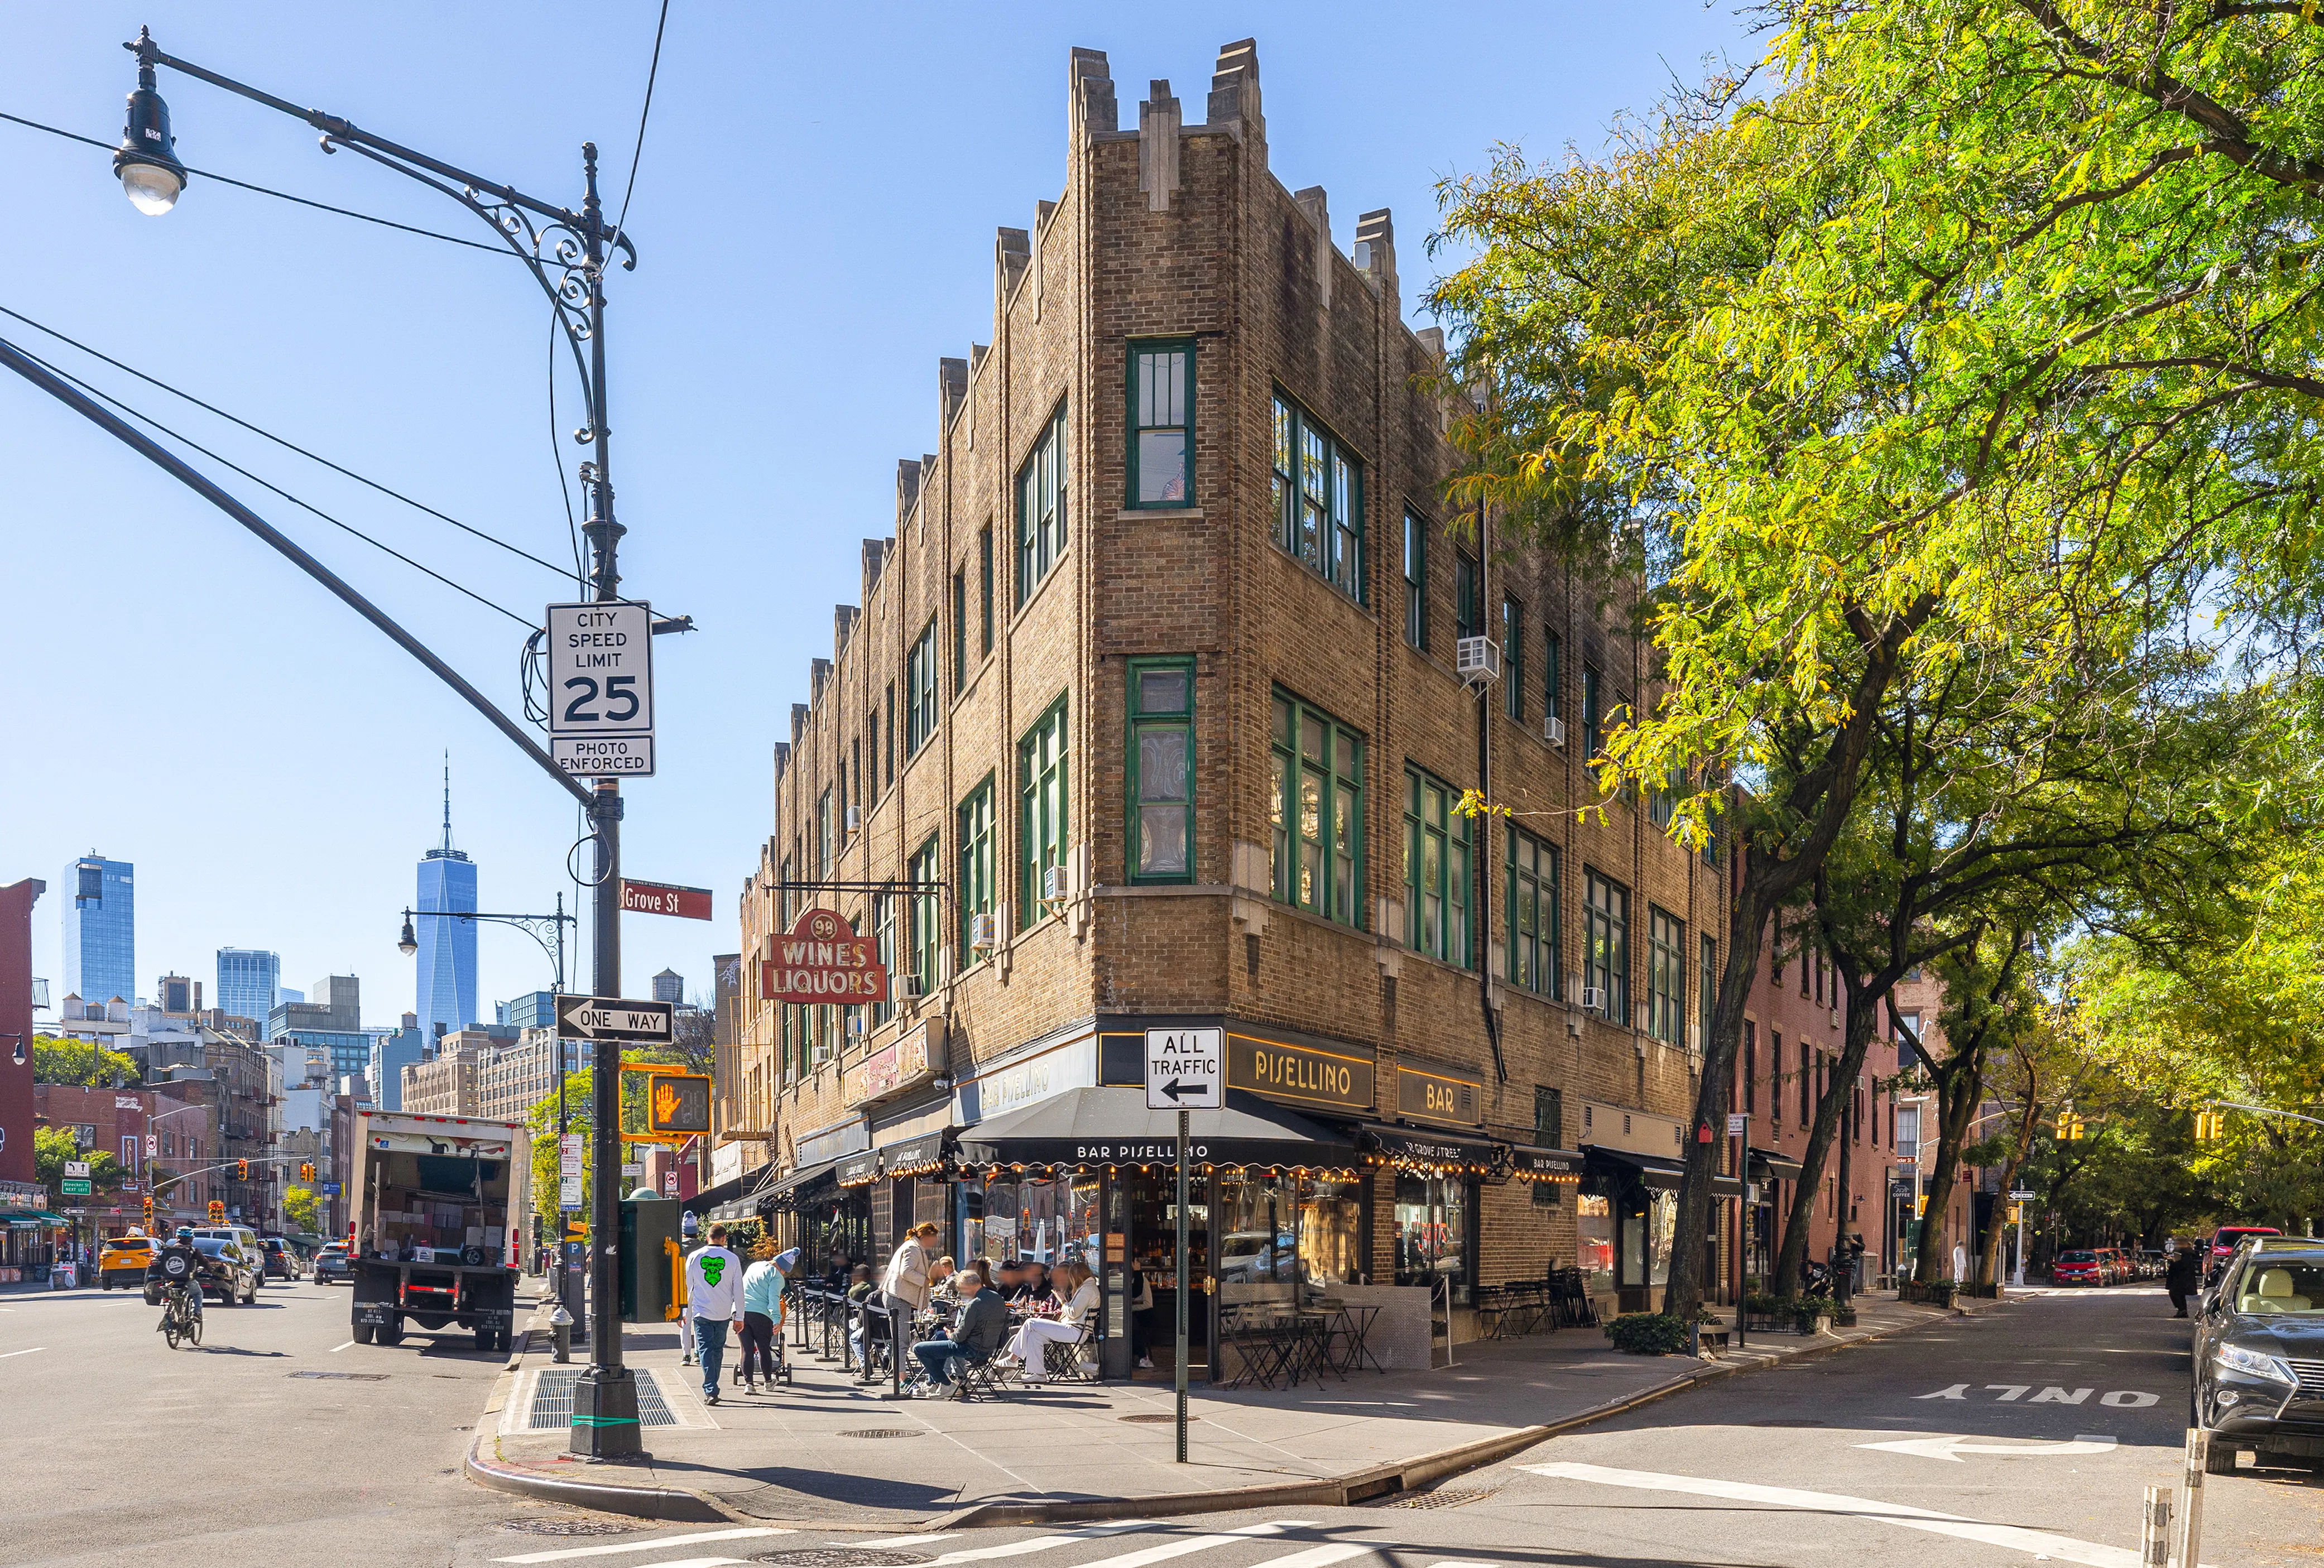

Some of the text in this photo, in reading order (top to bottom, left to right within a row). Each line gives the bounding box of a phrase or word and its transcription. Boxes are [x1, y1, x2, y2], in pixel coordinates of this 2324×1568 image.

[578, 612, 617, 627] CITY
[569, 633, 627, 648] SPEED
[576, 653, 622, 668] LIMIT
[564, 676, 640, 722] 25
[576, 742, 628, 755] PHOTO
[560, 757, 644, 770] ENFORCED
[626, 887, 679, 913] Grove St
[815, 920, 834, 935] 98
[782, 941, 867, 968] WINES
[773, 969, 877, 994] LIQUORS
[580, 1011, 660, 1030] ONE WAY
[1163, 1035, 1204, 1054] ALL
[1151, 1059, 1216, 1075] TRAFFIC
[1256, 1051, 1351, 1095] PISELLINO
[982, 1062, 1049, 1110] BAR PISELLINO
[1427, 1084, 1454, 1113] BAR
[1078, 1146, 1208, 1158] BAR PISELLO
[1415, 1144, 1434, 1156] GROVE
[1534, 1158, 1569, 1171] BAR PISELLINO
[572, 1243, 578, 1253] P
[1909, 1384, 2160, 1407] ONLY
